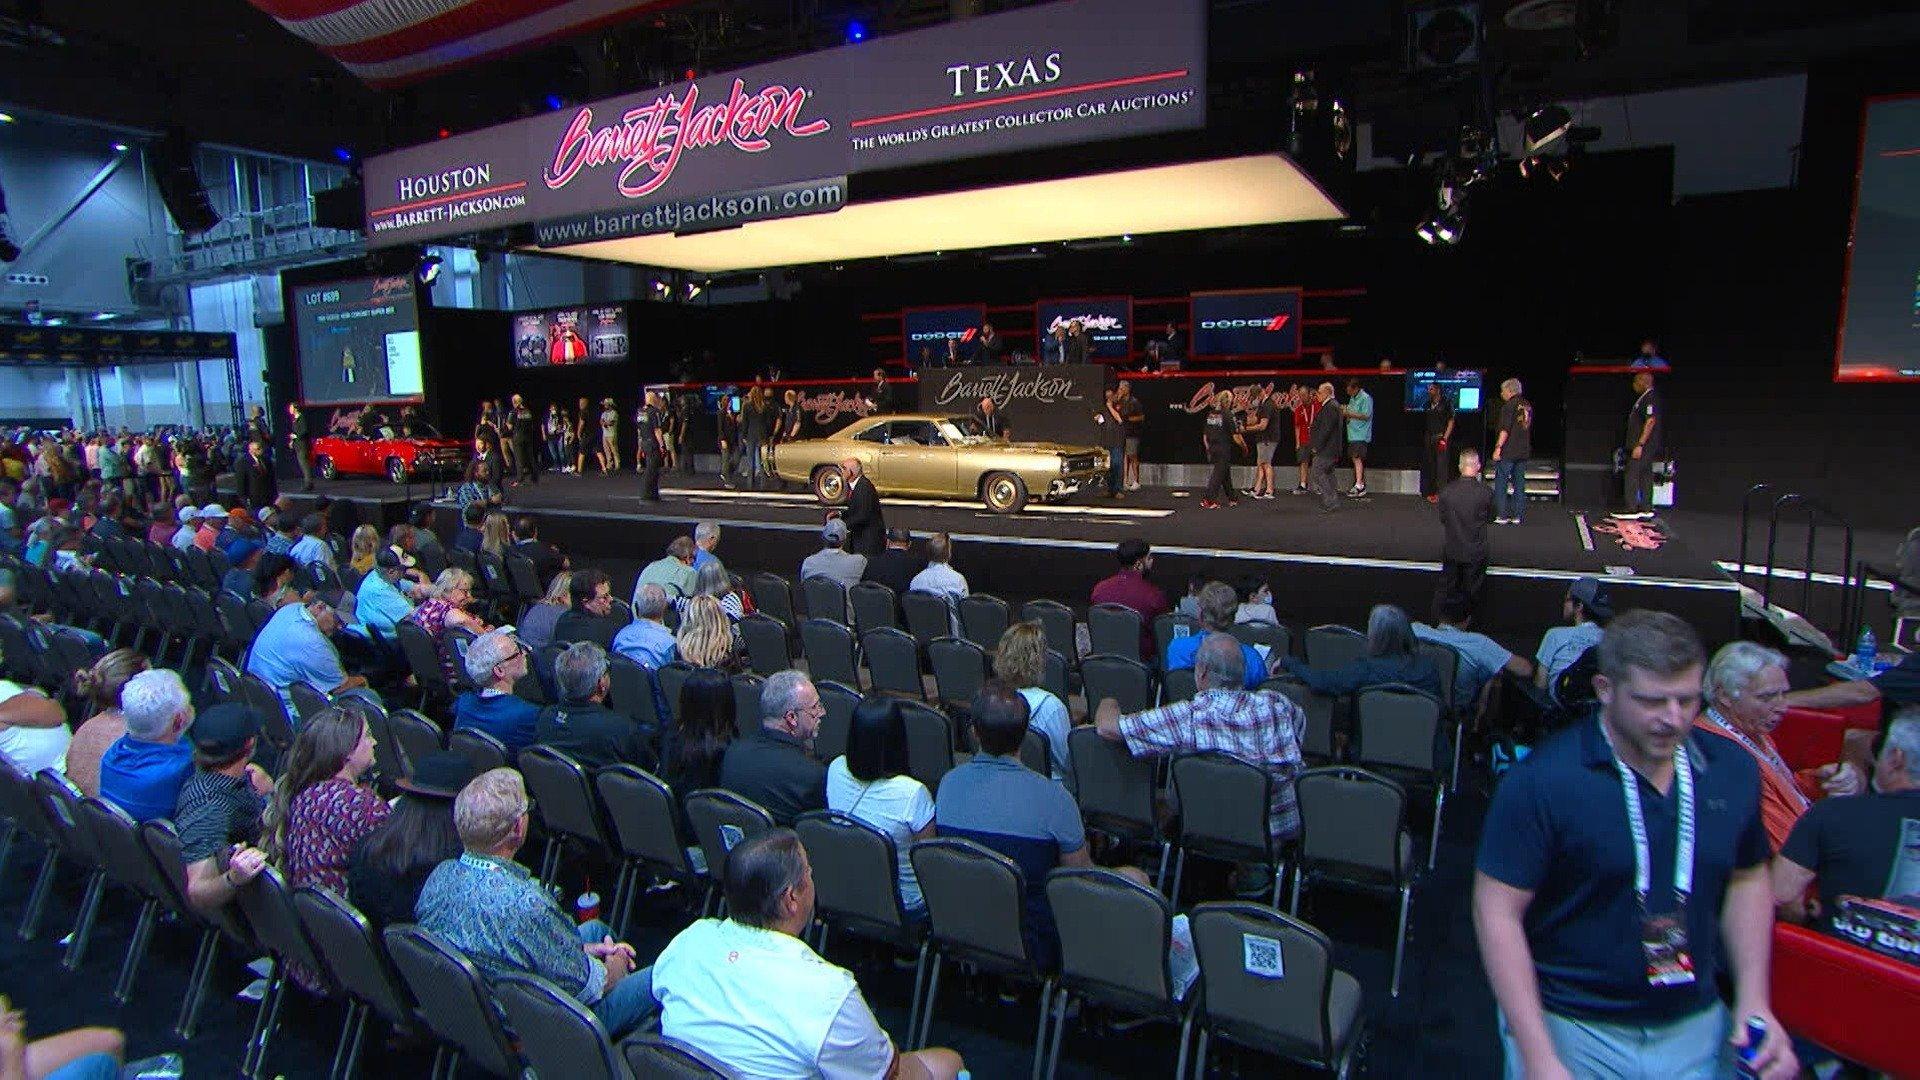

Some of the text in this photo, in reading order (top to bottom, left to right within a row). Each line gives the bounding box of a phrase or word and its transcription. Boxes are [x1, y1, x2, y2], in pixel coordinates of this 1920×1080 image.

[947, 53, 1063, 96] TEXAS
[852, 137, 875, 150] THE
[878, 127, 928, 147] WORLD'S
[931, 119, 992, 139] GREATEST
[995, 107, 1074, 129] COLLECTOR
[1076, 103, 1107, 118] CAR
[400, 163, 491, 200] HOUSTON
[911, 331, 965, 341] DODGE
[1201, 318, 1273, 329] DODGE
